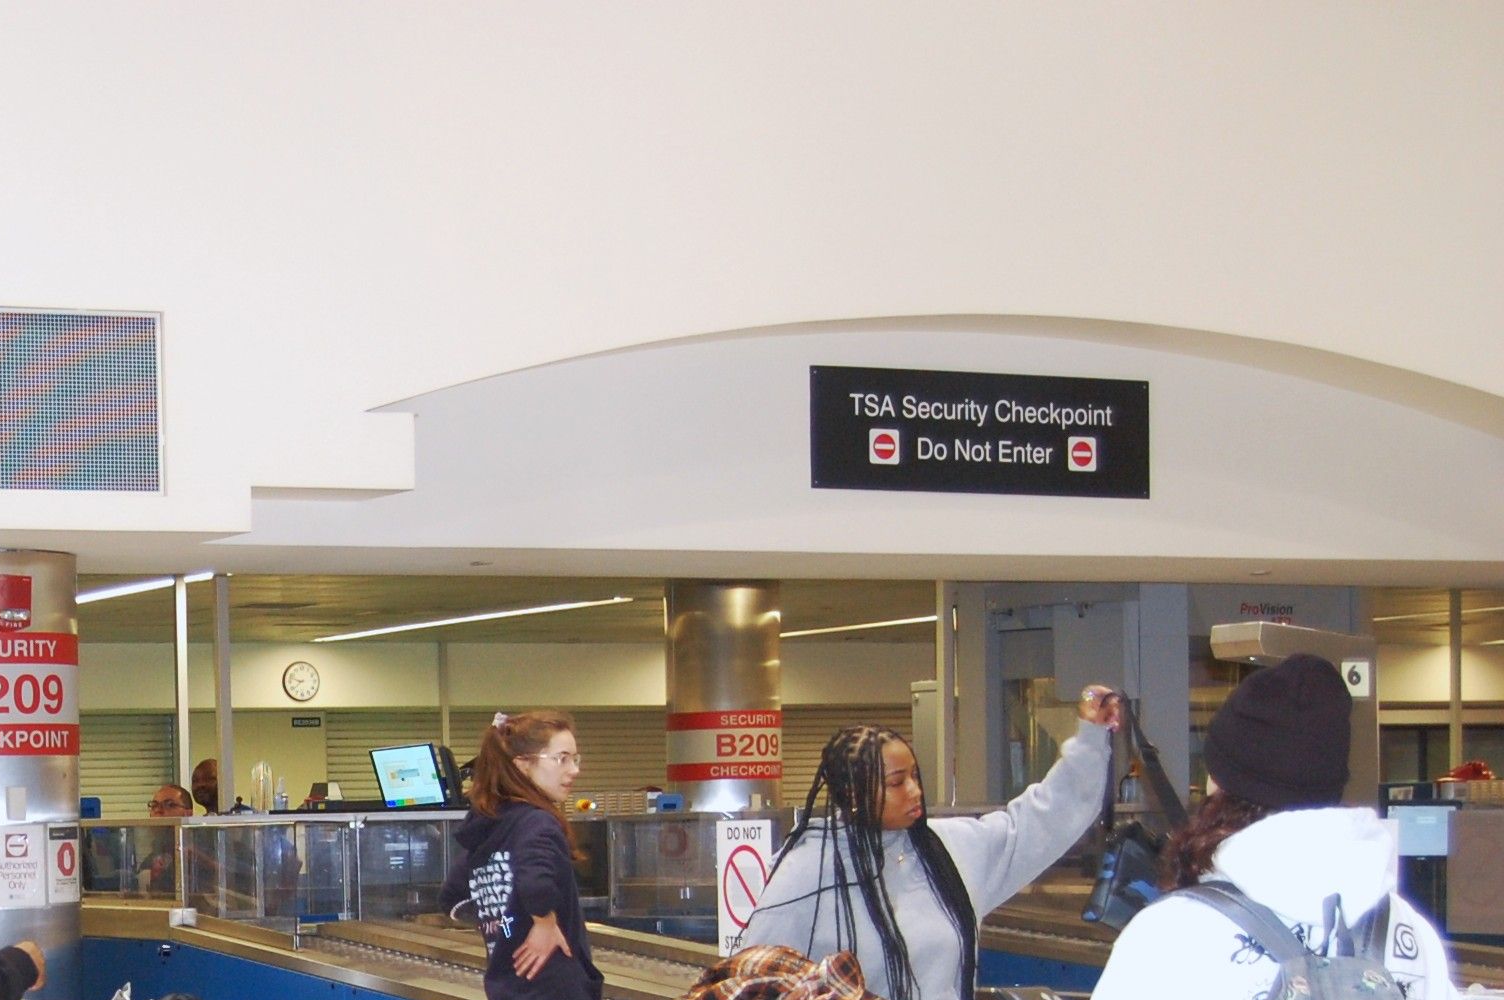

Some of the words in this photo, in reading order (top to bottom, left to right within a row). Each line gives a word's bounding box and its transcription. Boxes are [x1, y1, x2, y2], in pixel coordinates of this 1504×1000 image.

[850, 393, 896, 417] TSA
[902, 395, 988, 427] Security
[995, 400, 1112, 430] Checkpoint
[917, 437, 947, 461] Do
[954, 439, 992, 463] Not
[998, 441, 1053, 464] Enter
[1240, 603, 1293, 615] ProVision
[1347, 665, 1361, 686] 6
[720, 714, 776, 726] SECURITY
[716, 733, 779, 757] B209
[727, 827, 741, 840] DO
[742, 826, 762, 840] NOT
[8, 880, 26, 890] Only
